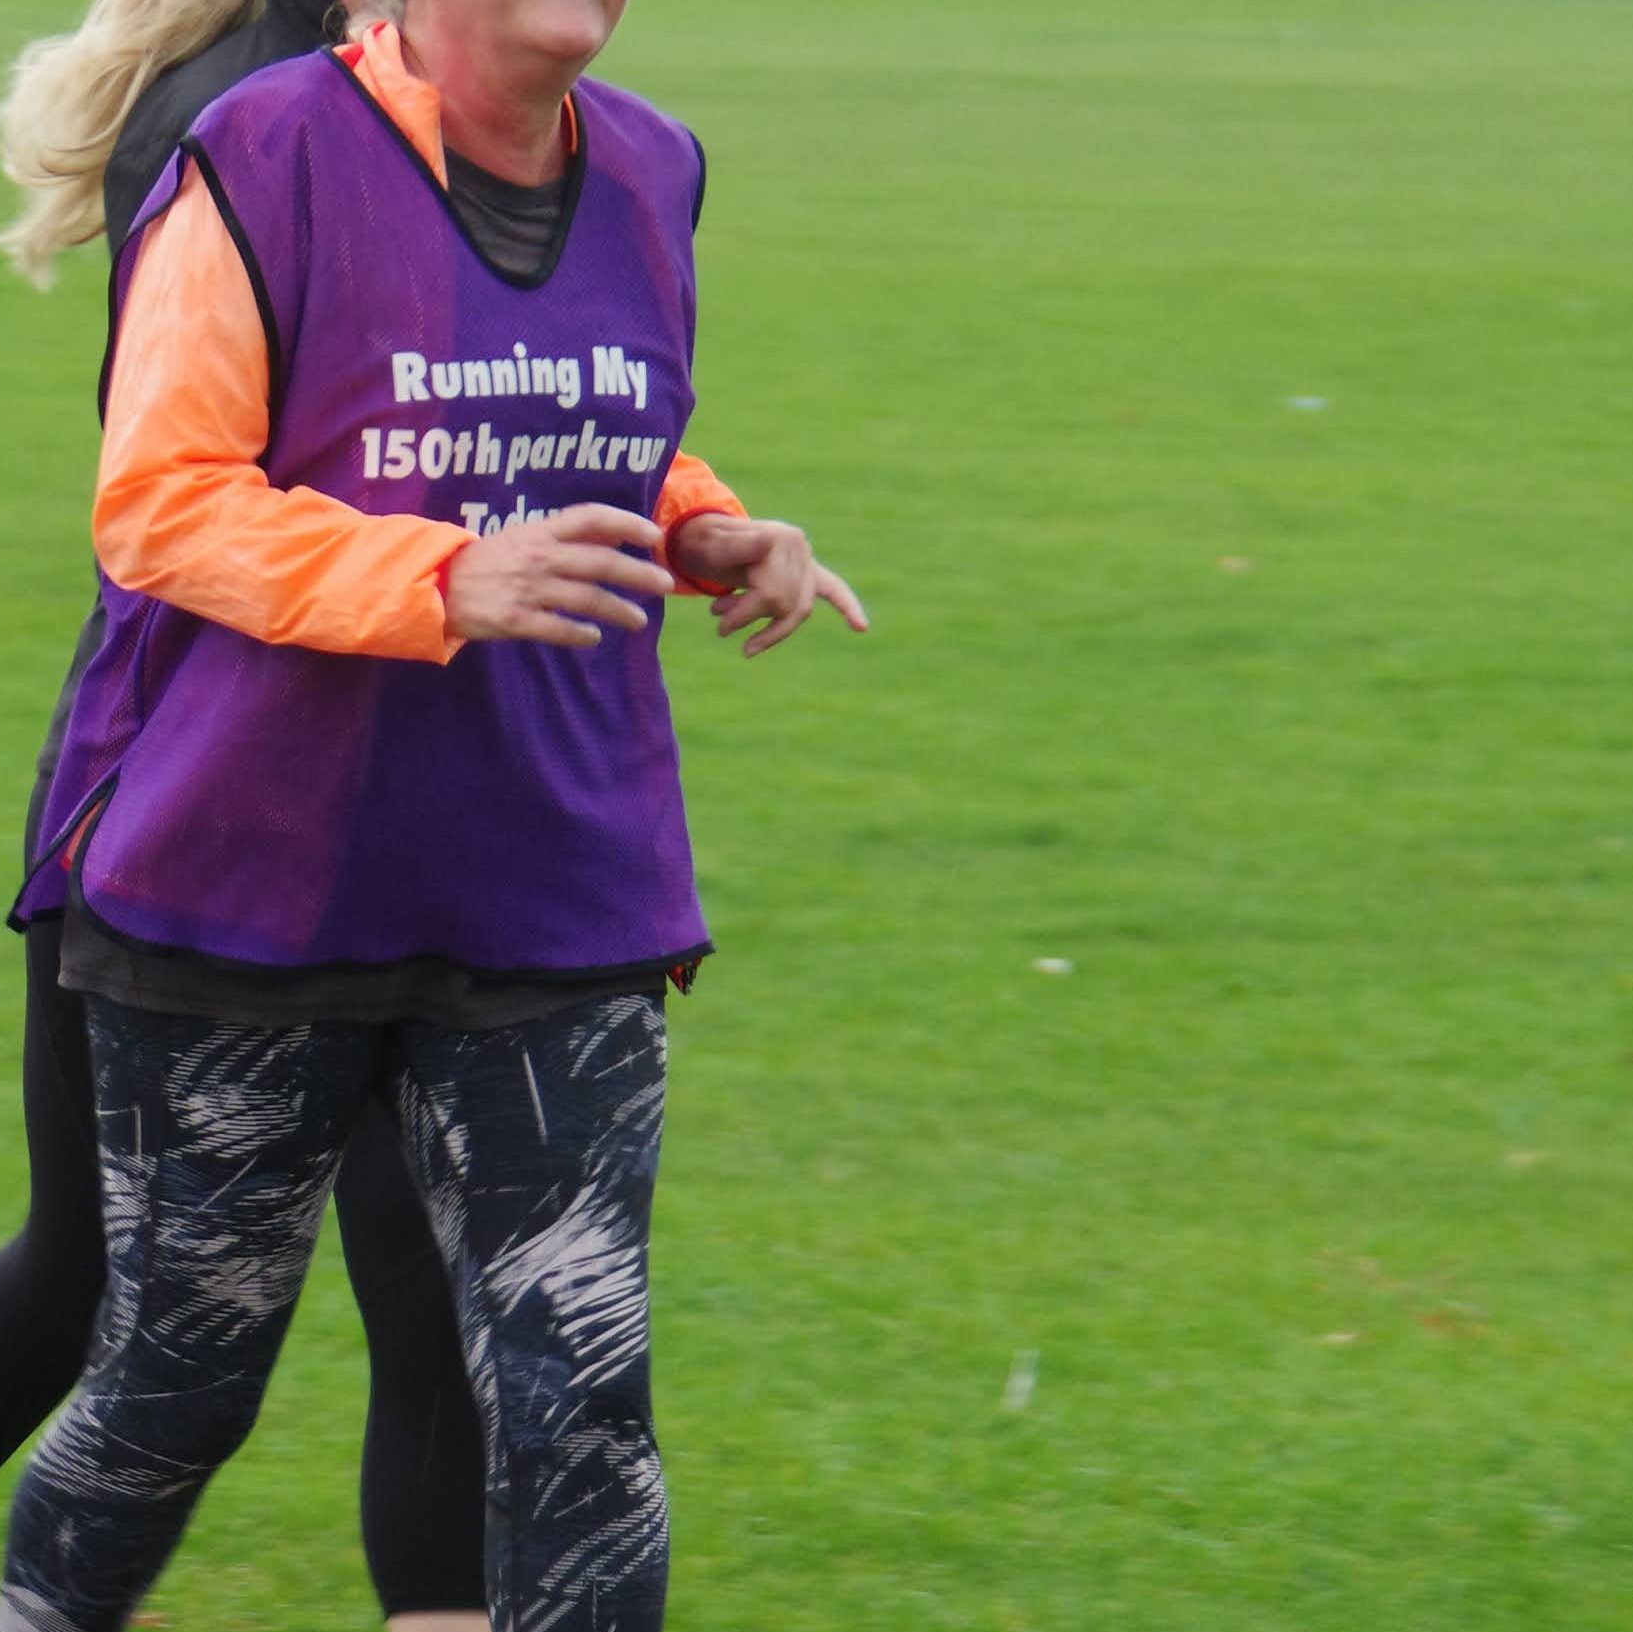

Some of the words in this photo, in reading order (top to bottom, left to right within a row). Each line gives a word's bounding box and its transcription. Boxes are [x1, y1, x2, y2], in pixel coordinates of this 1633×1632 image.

[391, 341, 581, 409] Running
[591, 345, 648, 411] My
[361, 421, 501, 479] 150th
[504, 419, 667, 485] parkrun
